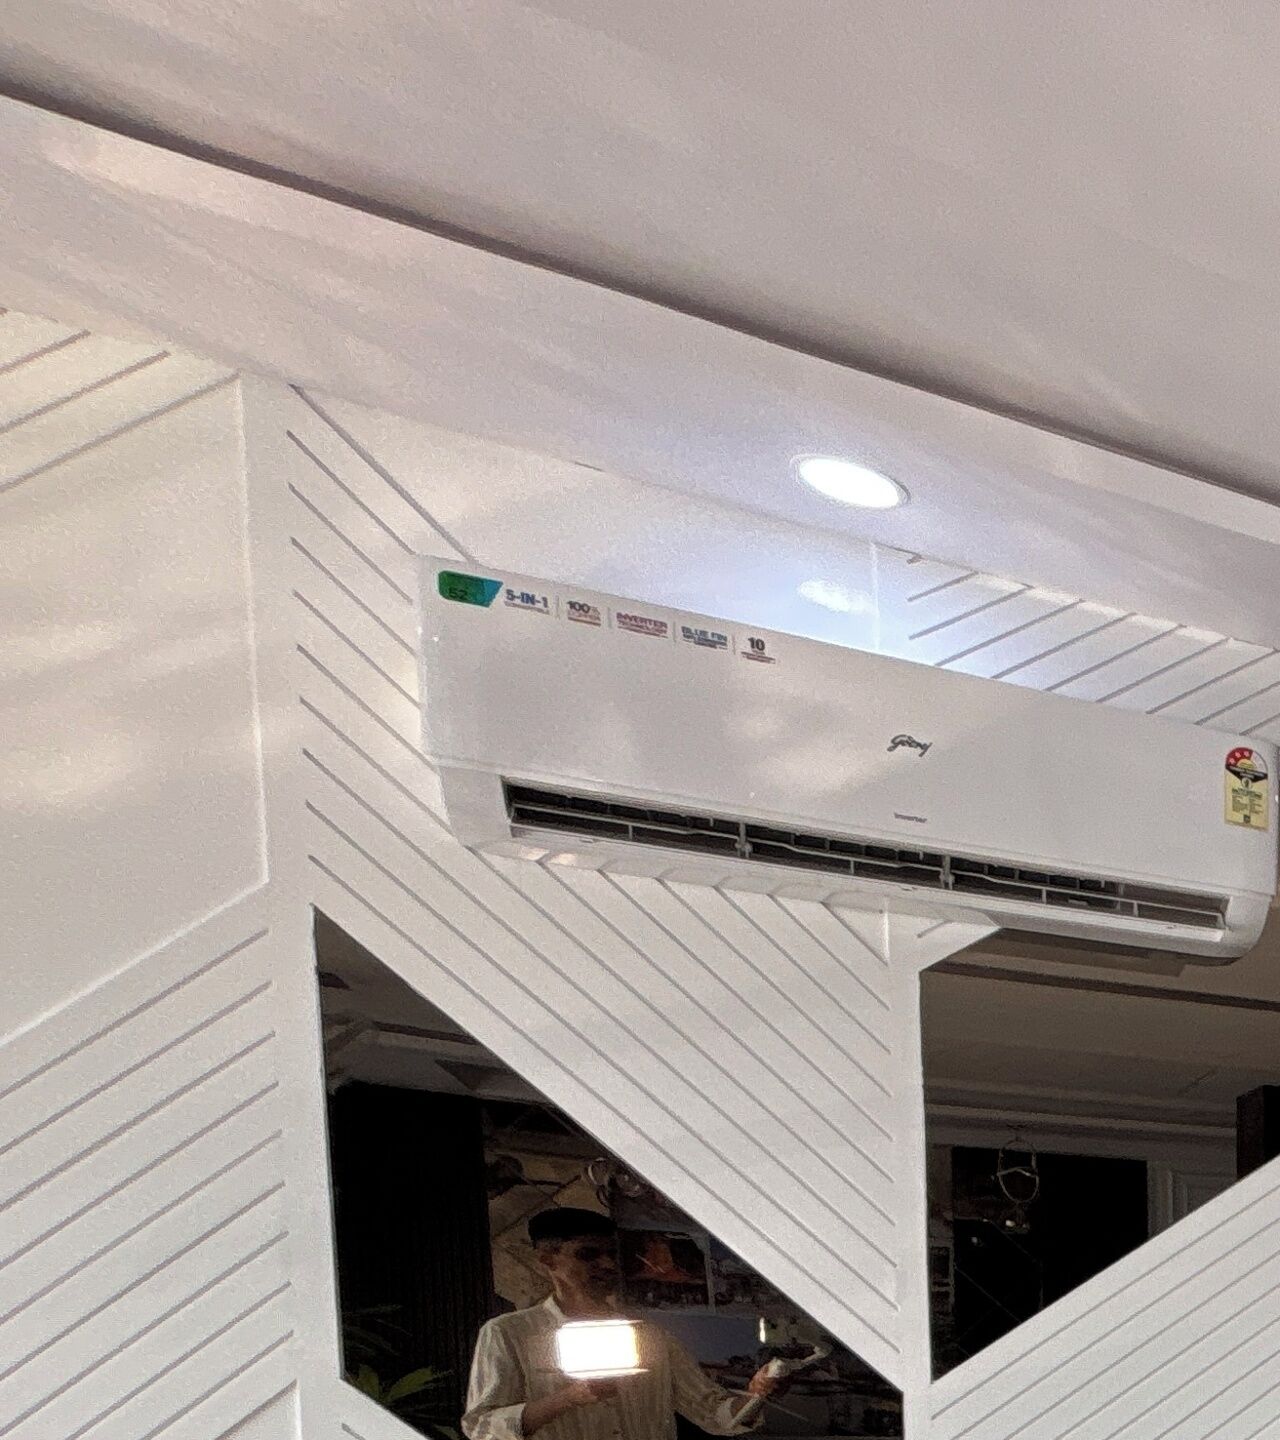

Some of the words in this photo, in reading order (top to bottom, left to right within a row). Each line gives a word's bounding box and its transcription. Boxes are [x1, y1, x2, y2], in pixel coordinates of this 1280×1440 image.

[505, 588, 548, 608] 5-IN-1
[615, 611, 669, 629] INVERTER
[748, 636, 766, 652] 10
